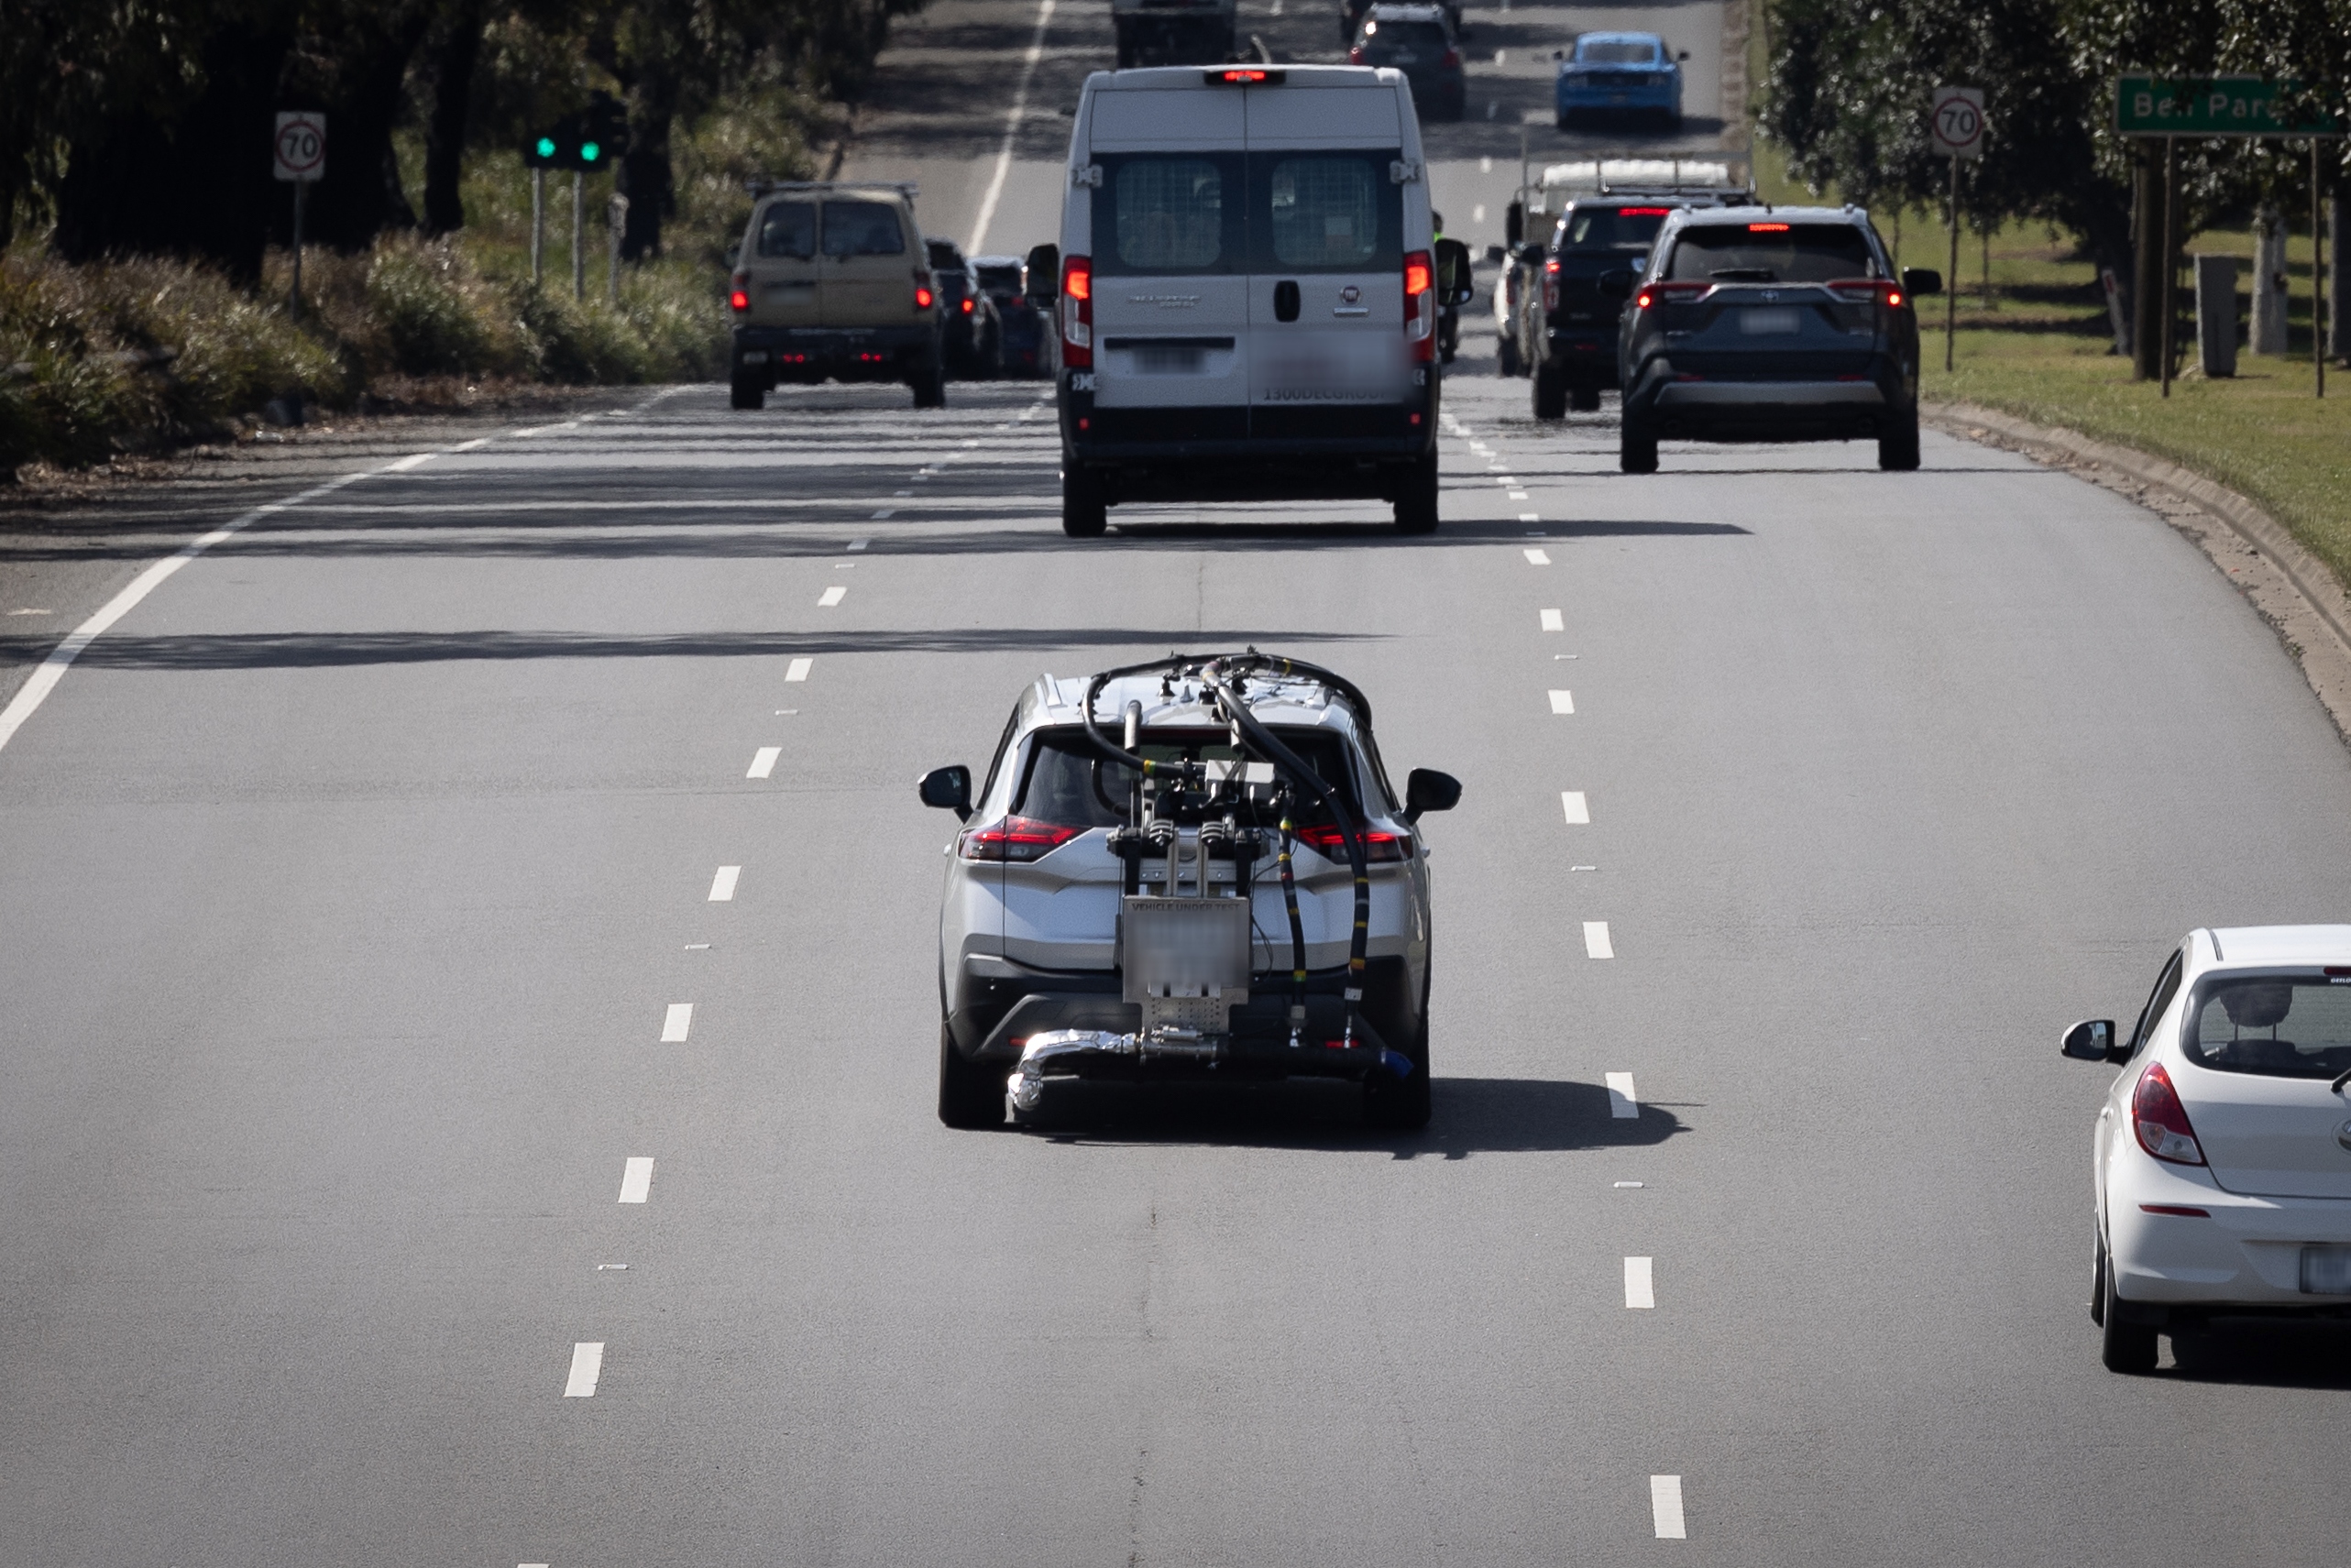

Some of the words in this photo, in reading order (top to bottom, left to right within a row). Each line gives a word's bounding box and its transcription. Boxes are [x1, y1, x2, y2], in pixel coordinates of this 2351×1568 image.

[1942, 109, 1975, 135] 70
[285, 132, 318, 159] 70
[1132, 903, 1173, 912] VEHICLE
[1176, 903, 1213, 912] UNDER
[1216, 903, 1240, 912] TEST
